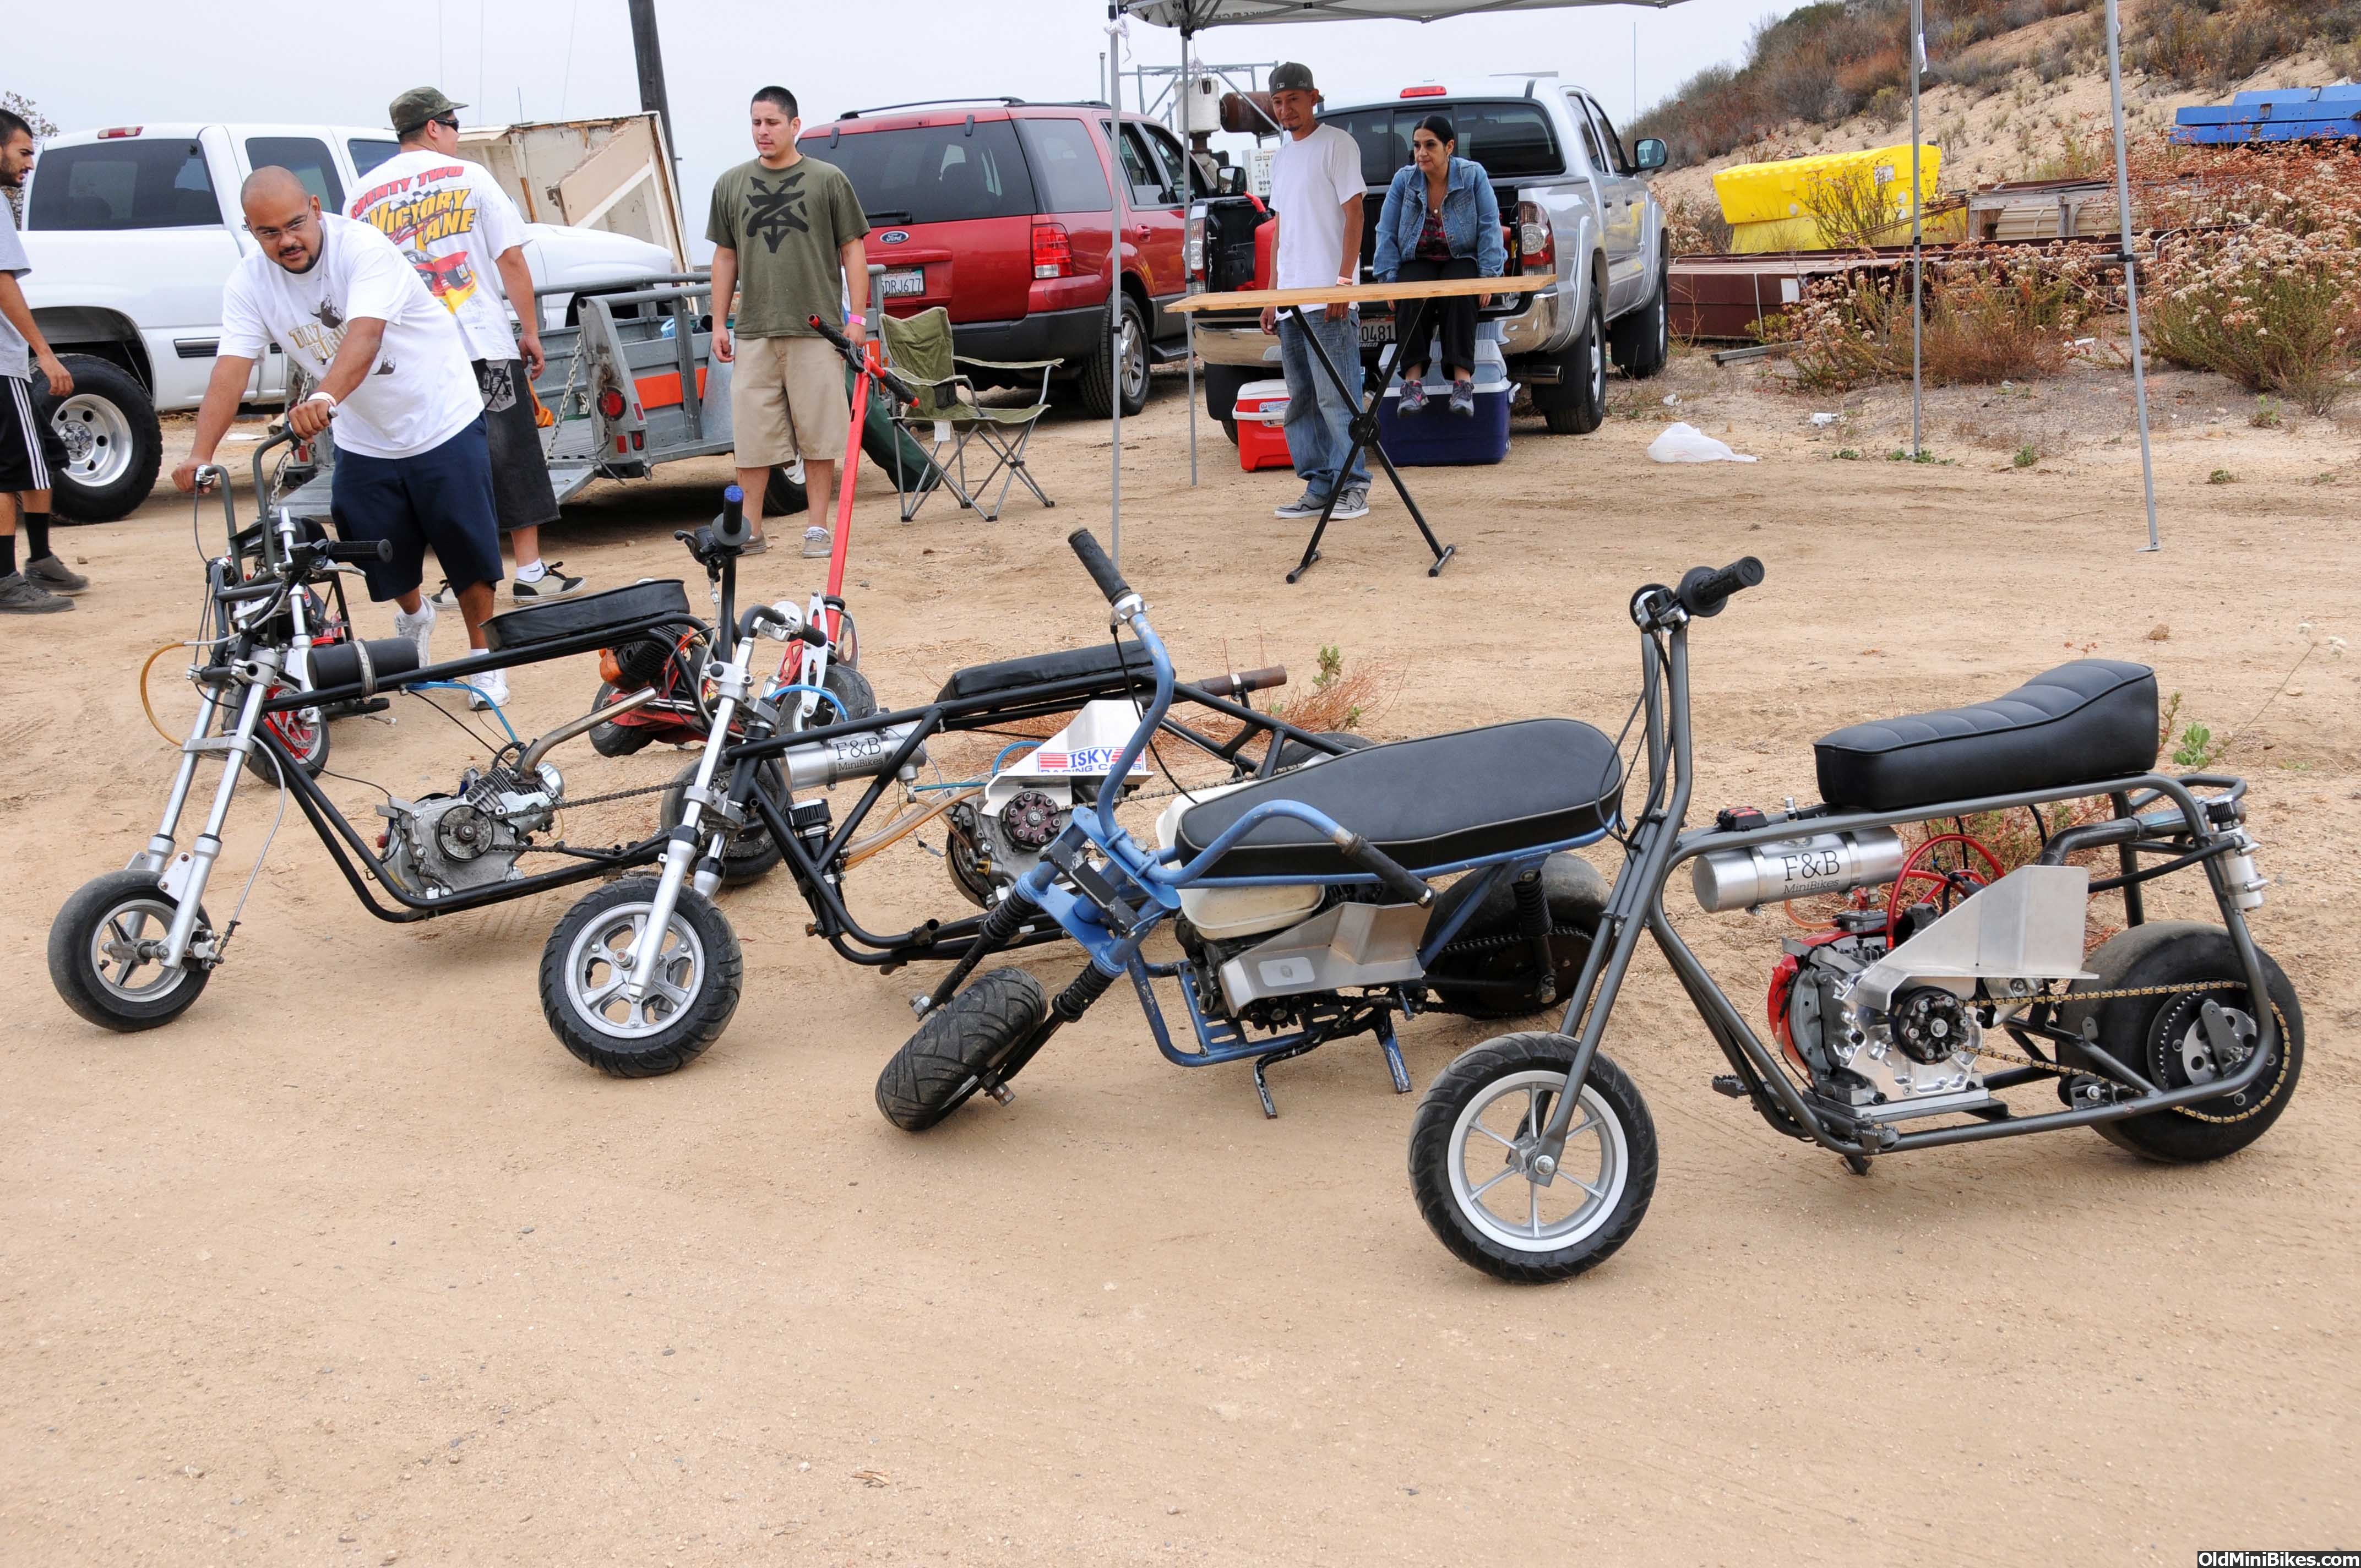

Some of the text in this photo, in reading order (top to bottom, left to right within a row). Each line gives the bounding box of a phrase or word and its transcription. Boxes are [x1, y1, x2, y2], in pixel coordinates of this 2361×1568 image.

[417, 166, 464, 187] TWO
[369, 188, 472, 234] VICTORY
[415, 208, 476, 252] LANE
[886, 233, 902, 242] Ford
[1359, 325, 1394, 341] 0481
[833, 737, 881, 760] F&B
[836, 758, 884, 771] MiniBikes
[1070, 749, 1112, 769] ISKY
[1781, 850, 1840, 881] F&B
[1783, 879, 1840, 895] MiniBikes
